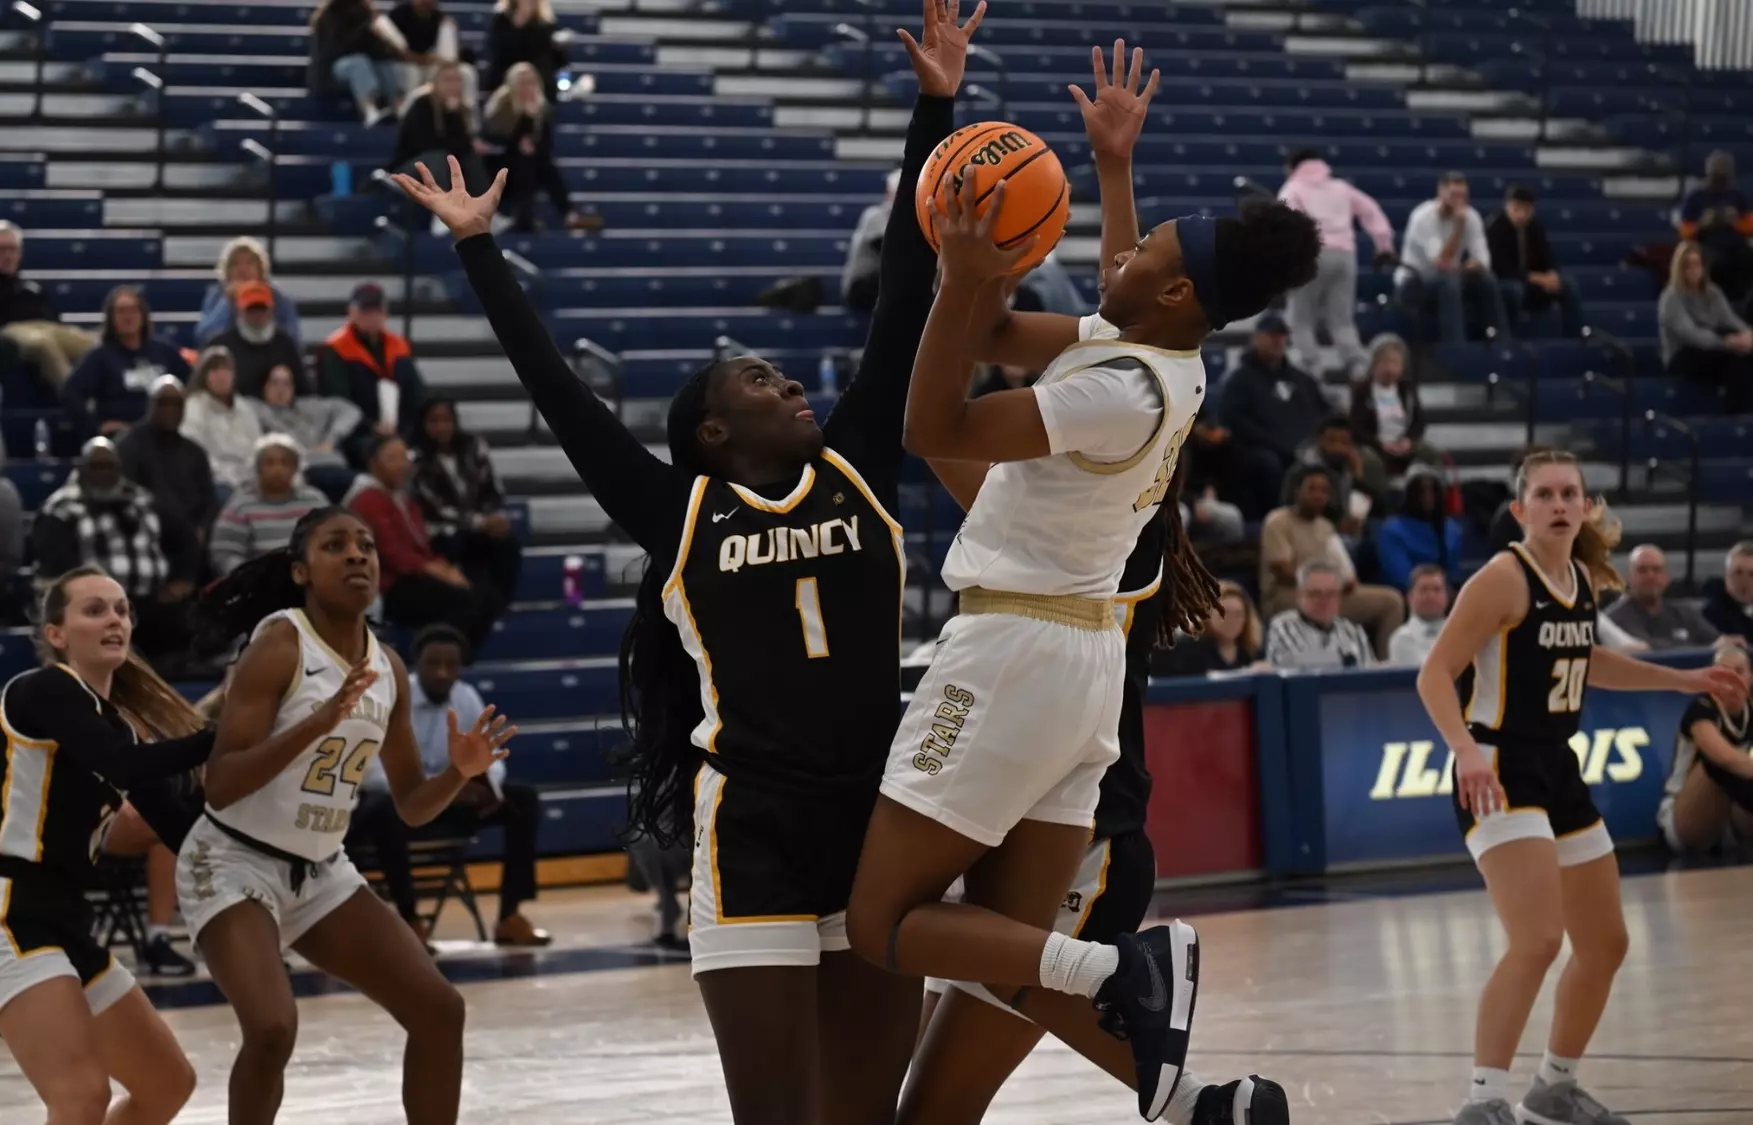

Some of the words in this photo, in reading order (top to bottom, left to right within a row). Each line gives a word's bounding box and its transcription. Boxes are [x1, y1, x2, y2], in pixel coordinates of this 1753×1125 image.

[954, 131, 1032, 195] Wils
[719, 515, 862, 573] QUINCY
[795, 576, 830, 659] 1
[1547, 657, 1588, 714] 20
[912, 684, 975, 776] STARS
[301, 736, 380, 800] 24
